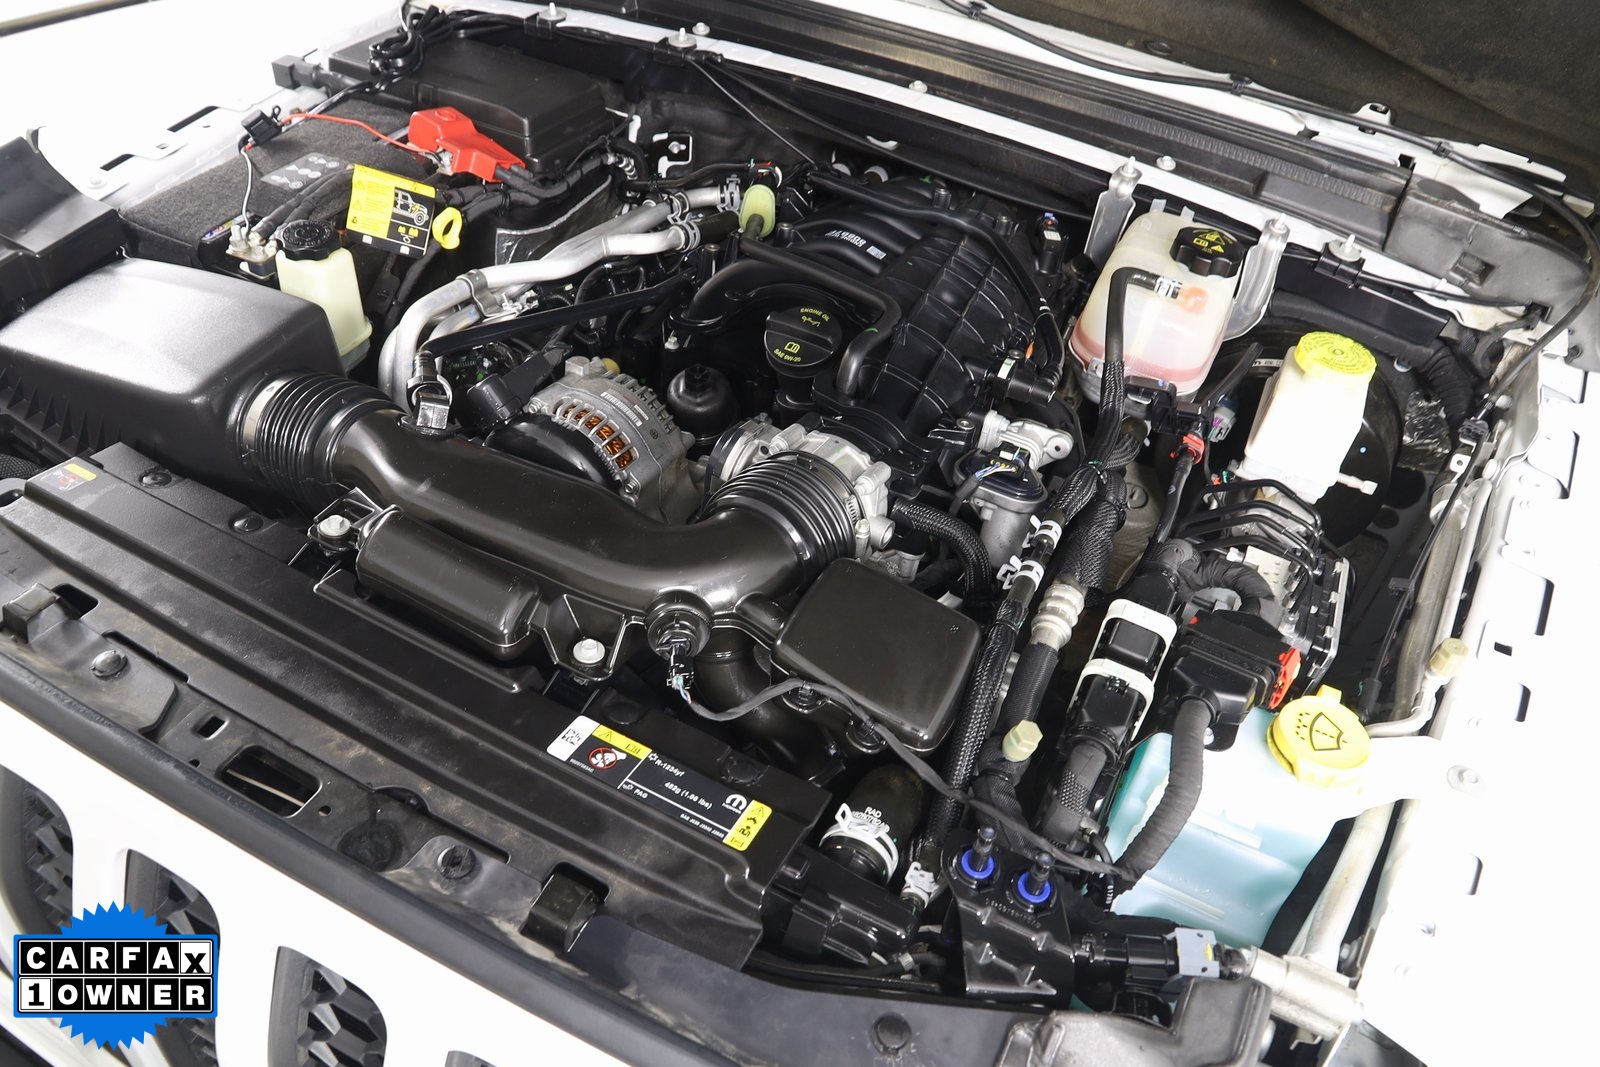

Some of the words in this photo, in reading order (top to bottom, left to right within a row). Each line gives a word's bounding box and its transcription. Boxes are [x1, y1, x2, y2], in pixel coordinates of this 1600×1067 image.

[800, 307, 823, 316] ENGINE
[773, 348, 784, 359] SAE
[654, 759, 686, 777] R-1234yf
[864, 806, 882, 818] RAD
